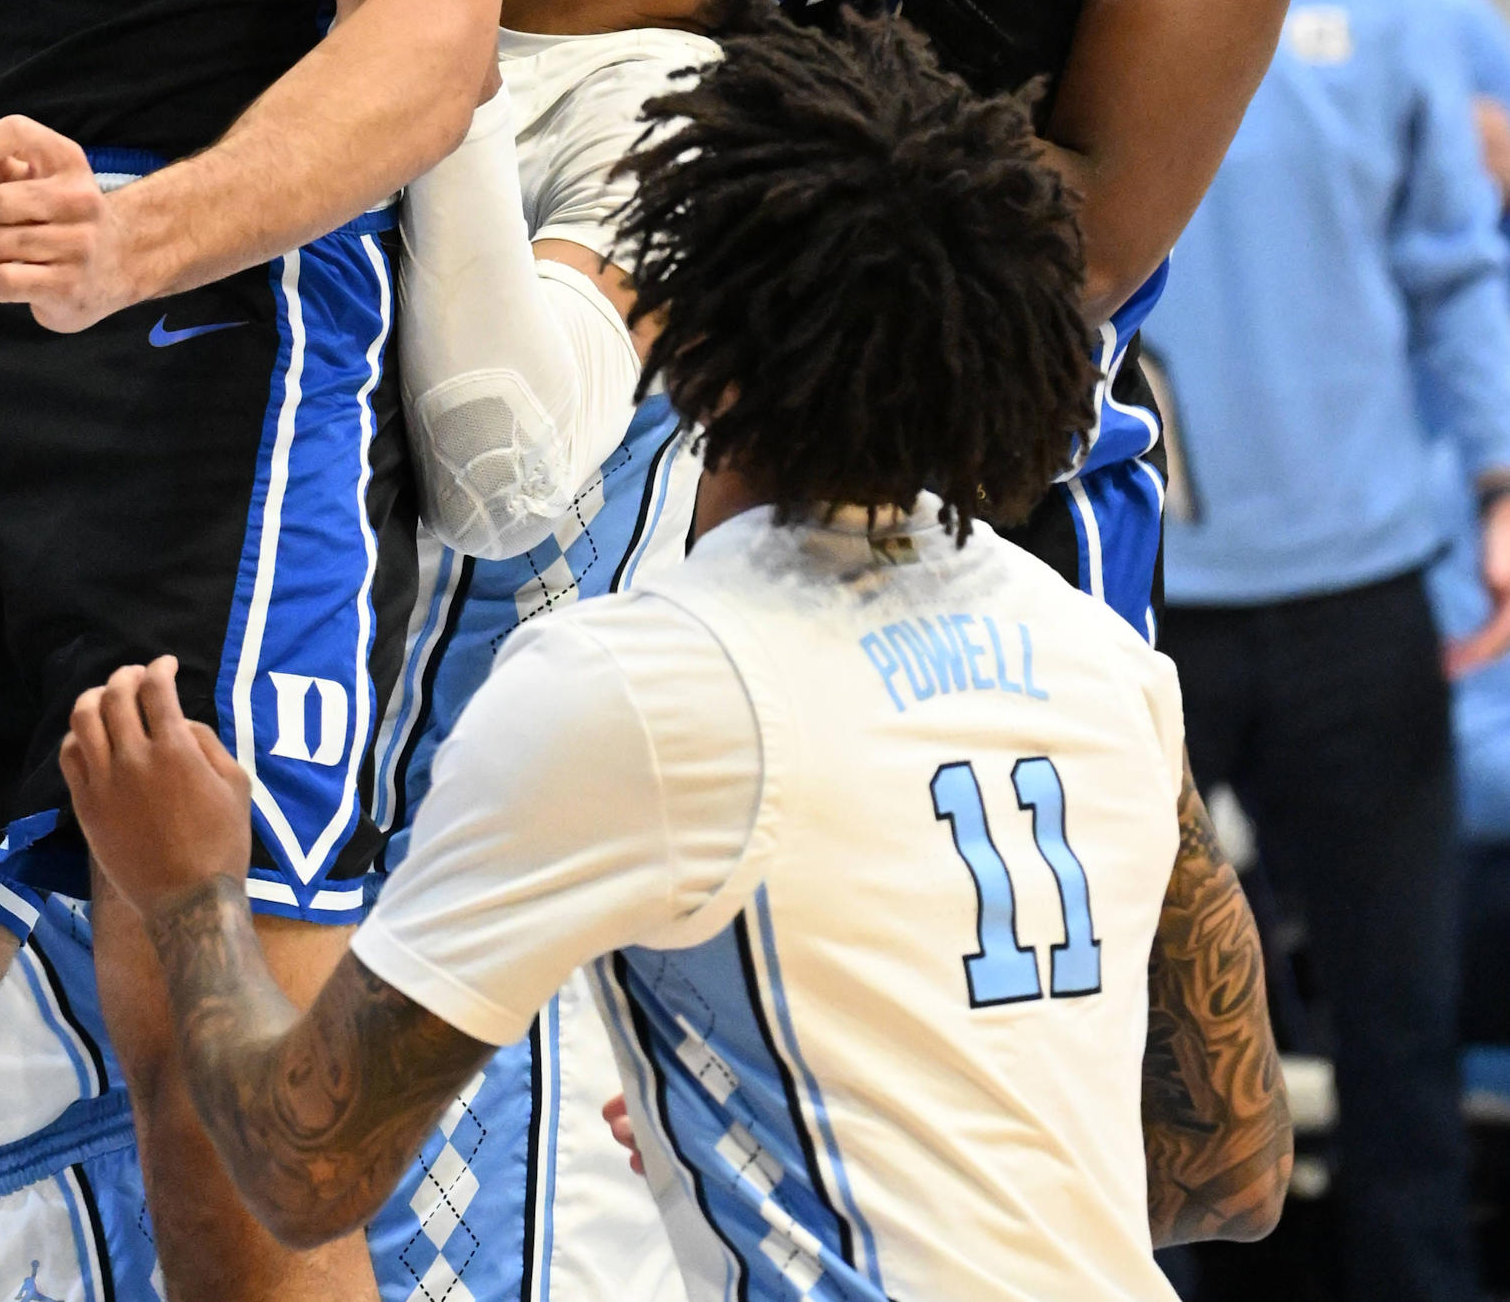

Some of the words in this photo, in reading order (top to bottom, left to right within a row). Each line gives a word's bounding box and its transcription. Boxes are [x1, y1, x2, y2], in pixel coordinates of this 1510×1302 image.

[859, 612, 1050, 713] POWELL
[268, 671, 348, 767] D
[930, 756, 1103, 1009] 11
